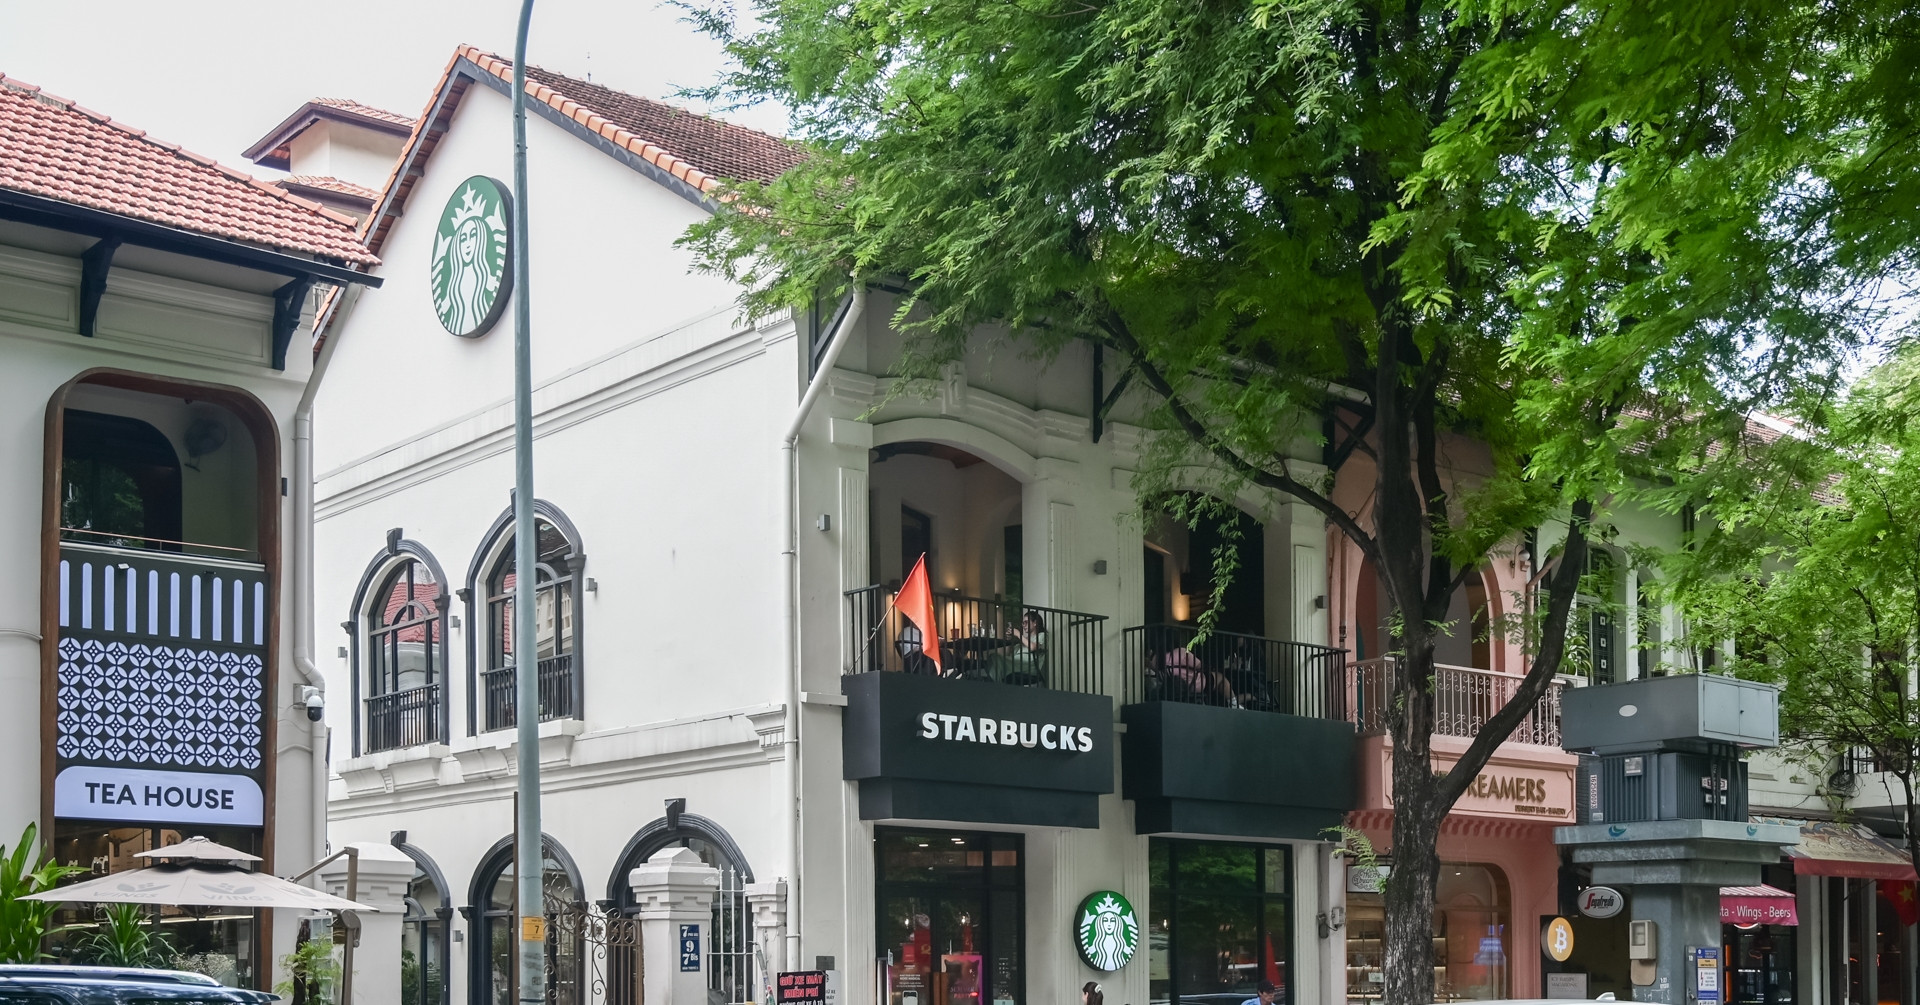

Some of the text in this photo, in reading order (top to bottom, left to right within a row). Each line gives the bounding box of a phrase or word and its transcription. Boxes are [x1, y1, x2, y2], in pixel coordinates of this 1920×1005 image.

[919, 711, 1094, 753] STARBUCKS
[1467, 774, 1547, 803] REAMERS
[85, 782, 234, 810] TEA HOUSE
[1736, 905, 1762, 920] Wings
[1769, 906, 1791, 918] Beers
[534, 925, 539, 934] 7
[681, 925, 689, 938] 7
[685, 940, 695, 953] 9
[682, 953, 690, 966] 7
[795, 976, 805, 985] XE
[806, 974, 823, 984] MÁY
[806, 986, 818, 997] PHÍ
